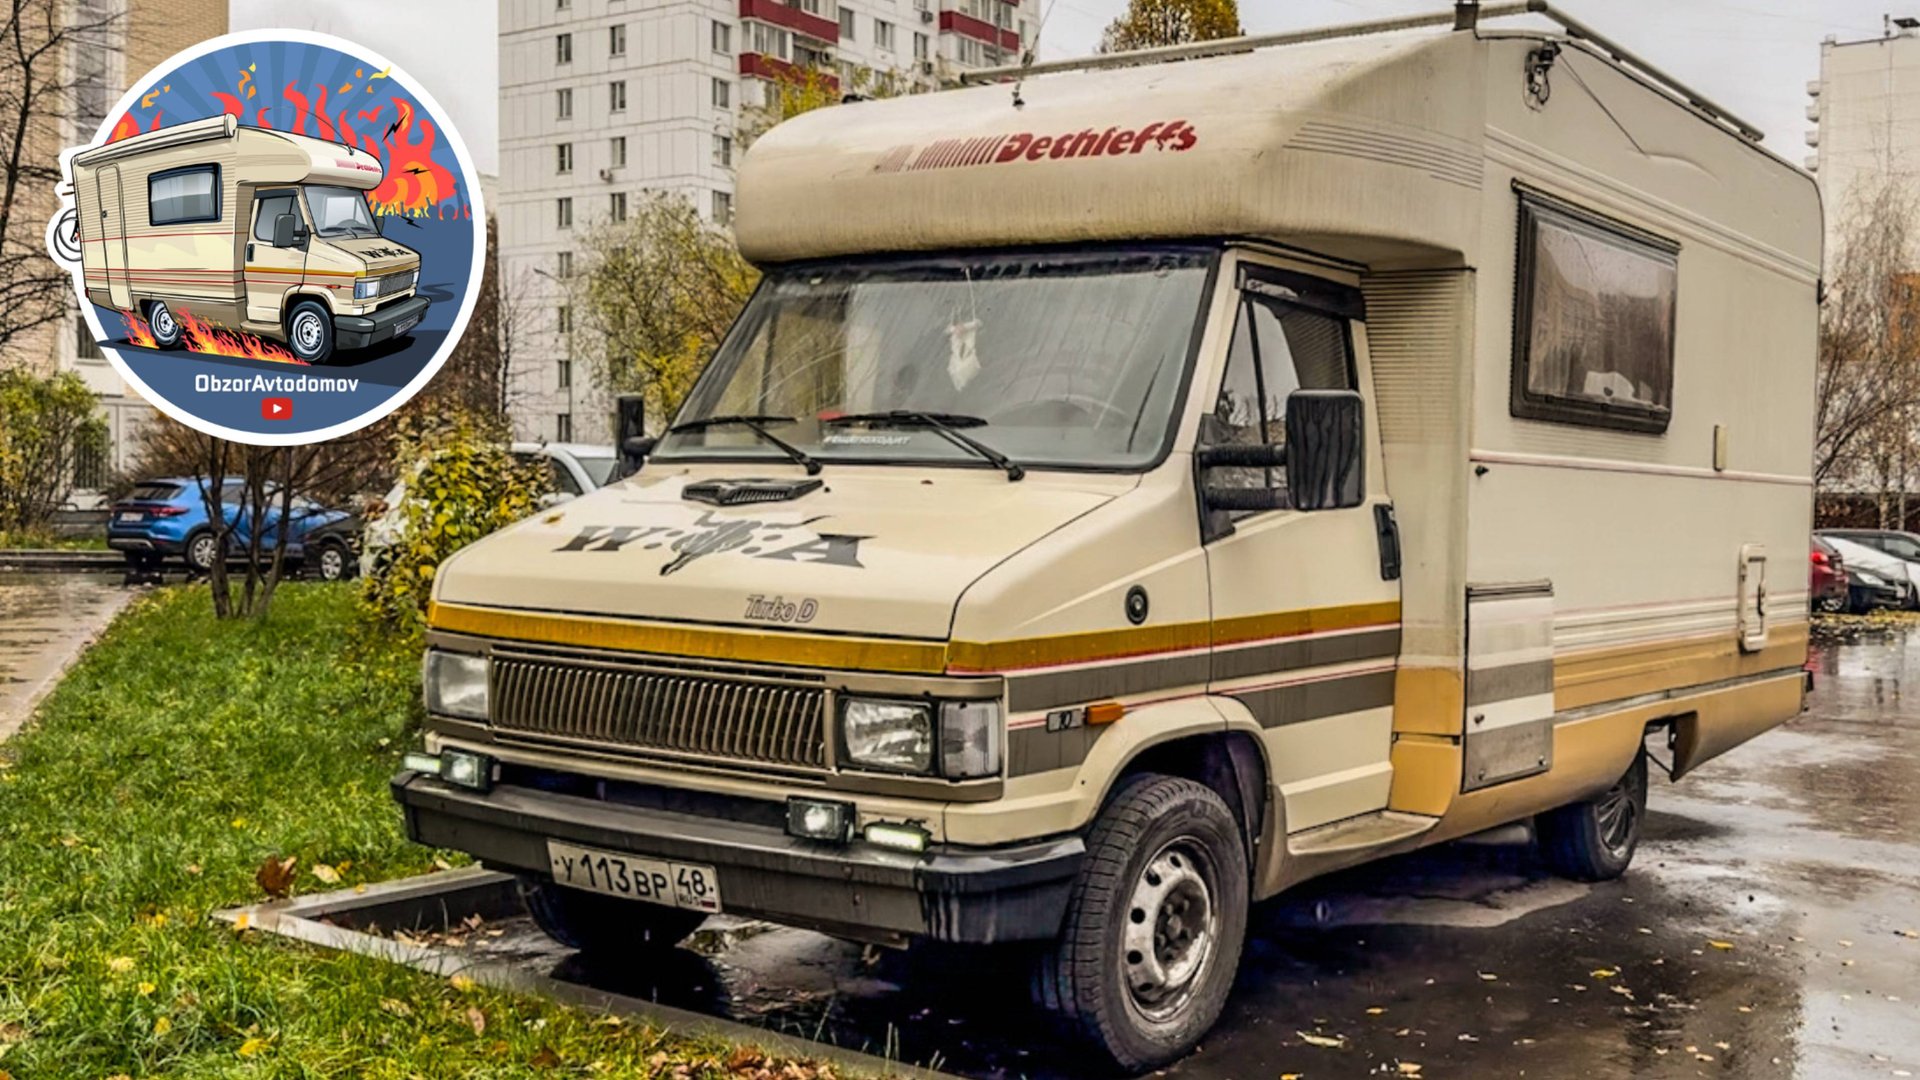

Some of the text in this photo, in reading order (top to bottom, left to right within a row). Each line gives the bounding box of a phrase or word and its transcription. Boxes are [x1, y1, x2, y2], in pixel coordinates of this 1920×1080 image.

[744, 594, 819, 623] Turbo D
[677, 868, 707, 896] 48
